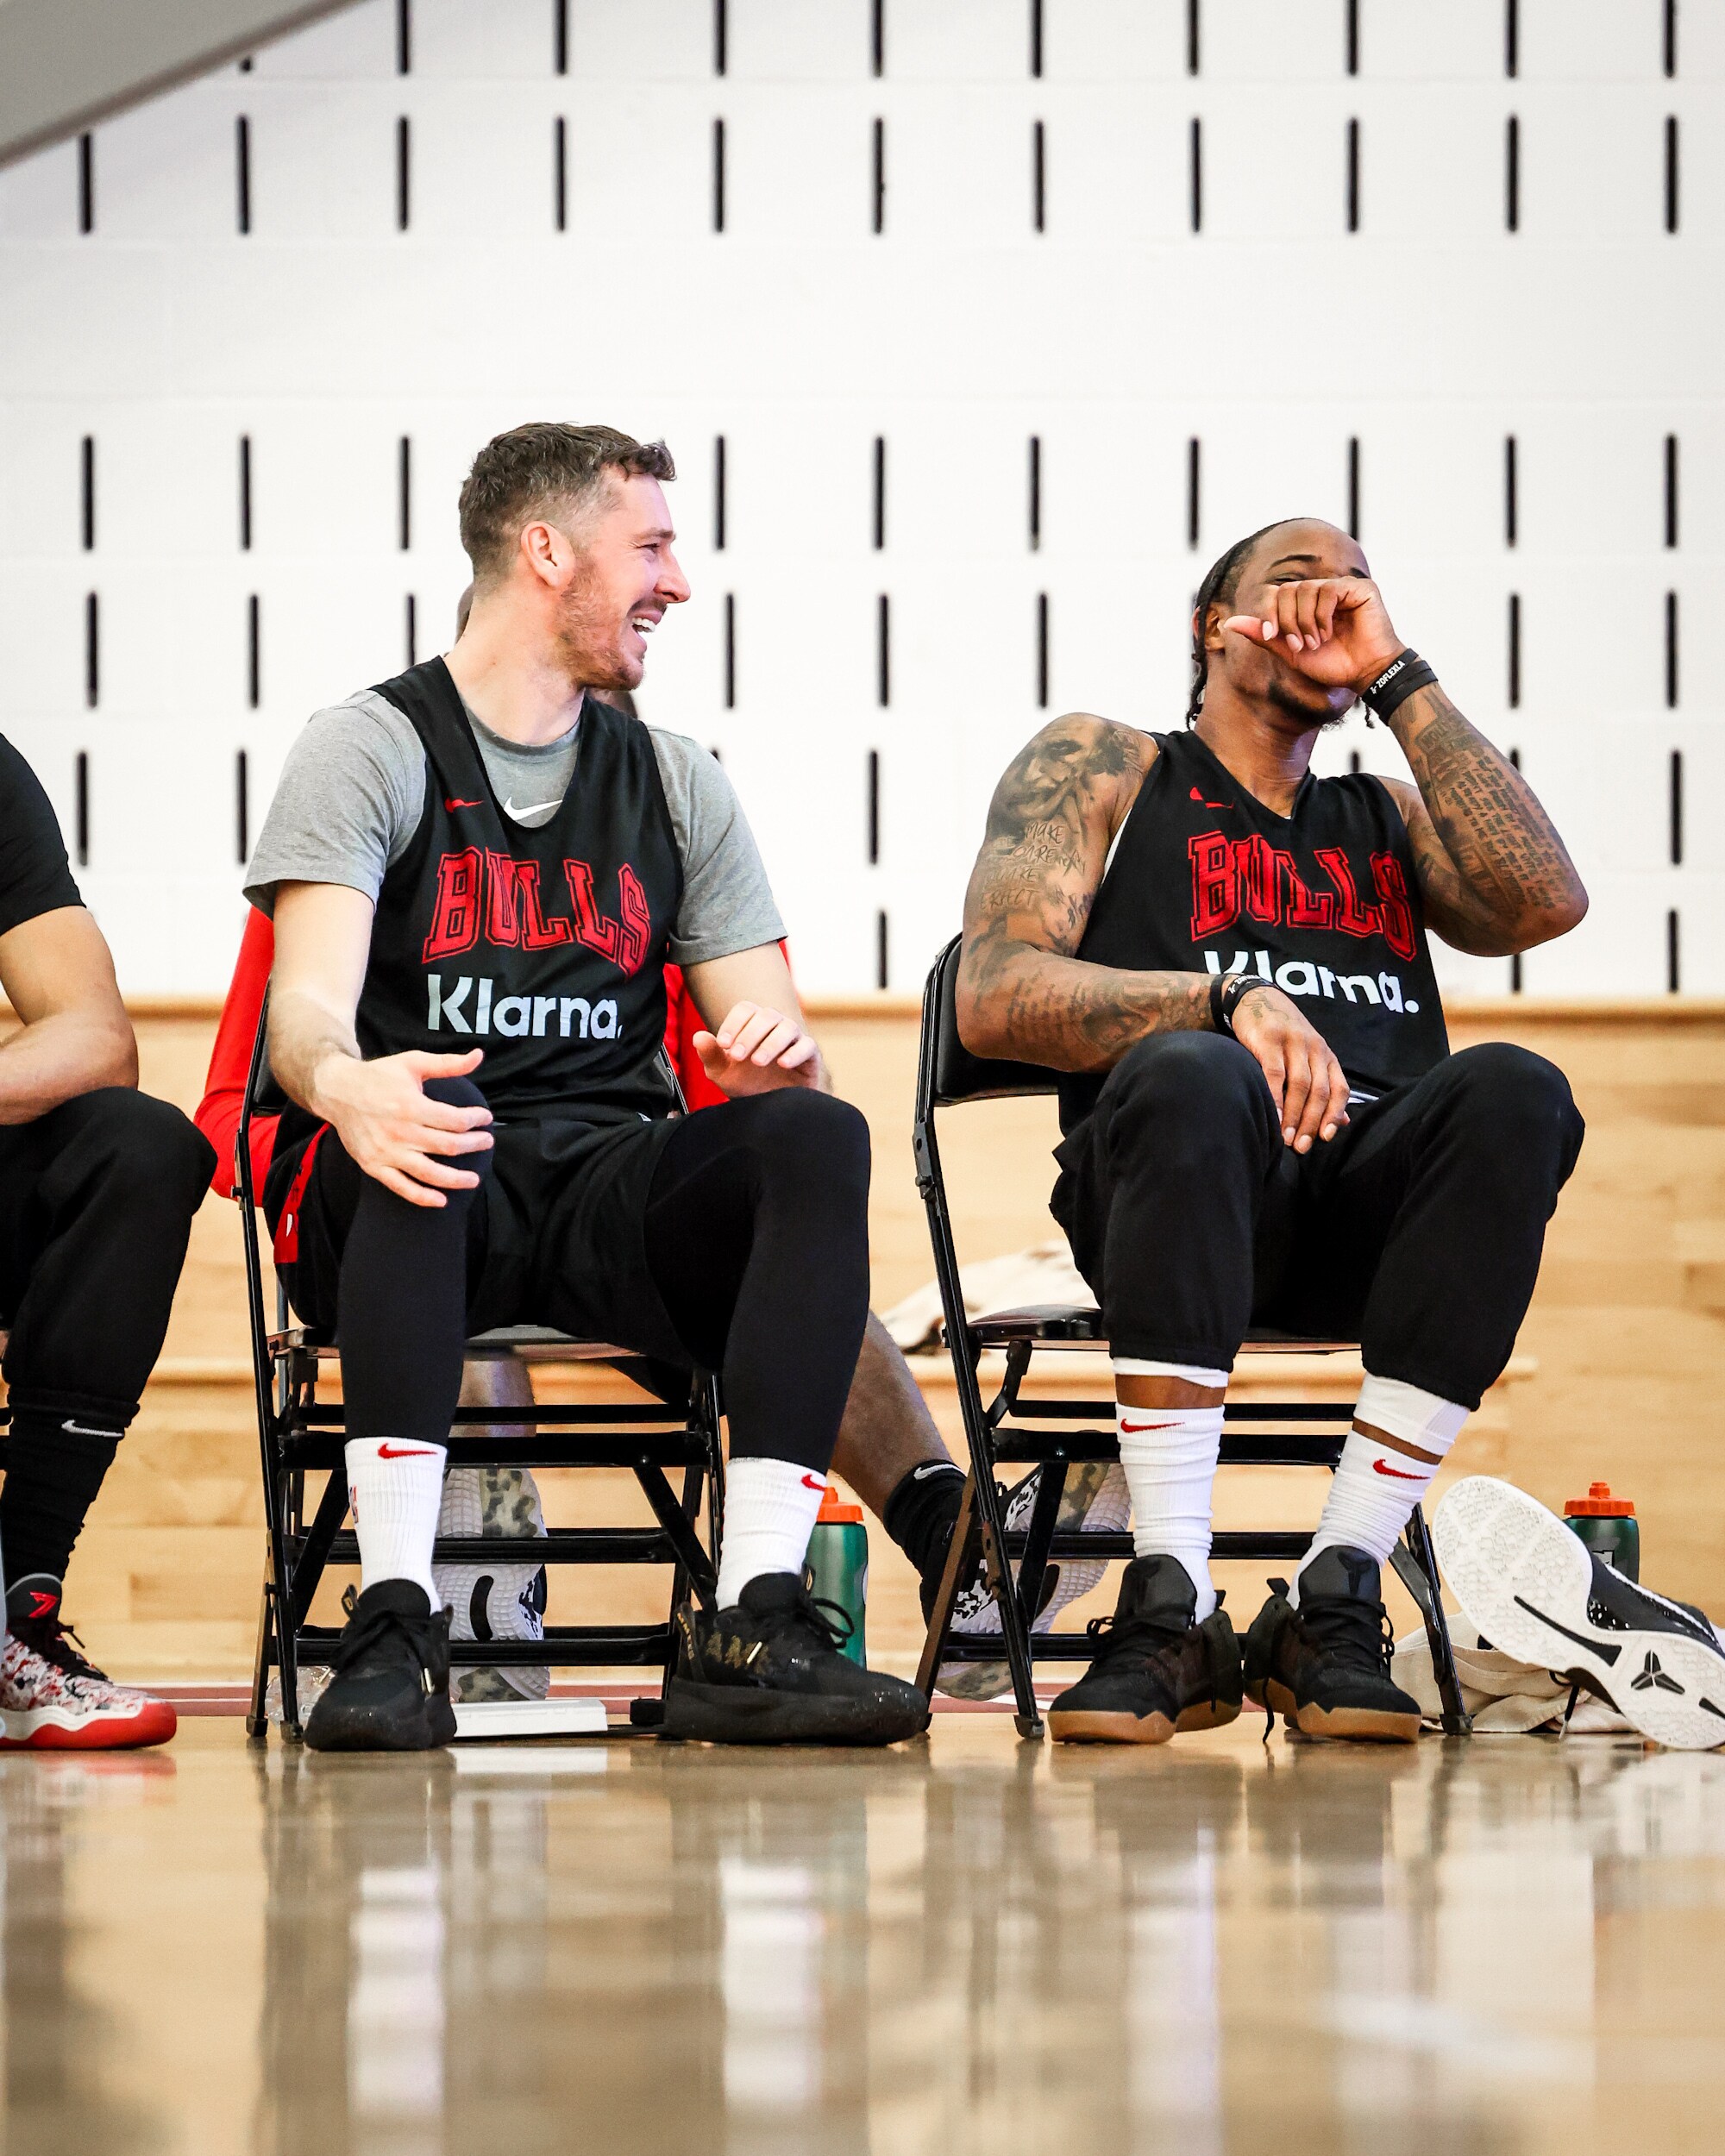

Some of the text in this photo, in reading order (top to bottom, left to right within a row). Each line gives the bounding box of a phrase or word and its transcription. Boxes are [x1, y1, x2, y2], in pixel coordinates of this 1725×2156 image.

[1025, 821, 1064, 843] MAKE
[1188, 830, 1416, 962] BULLS
[422, 845, 650, 979] BULLS
